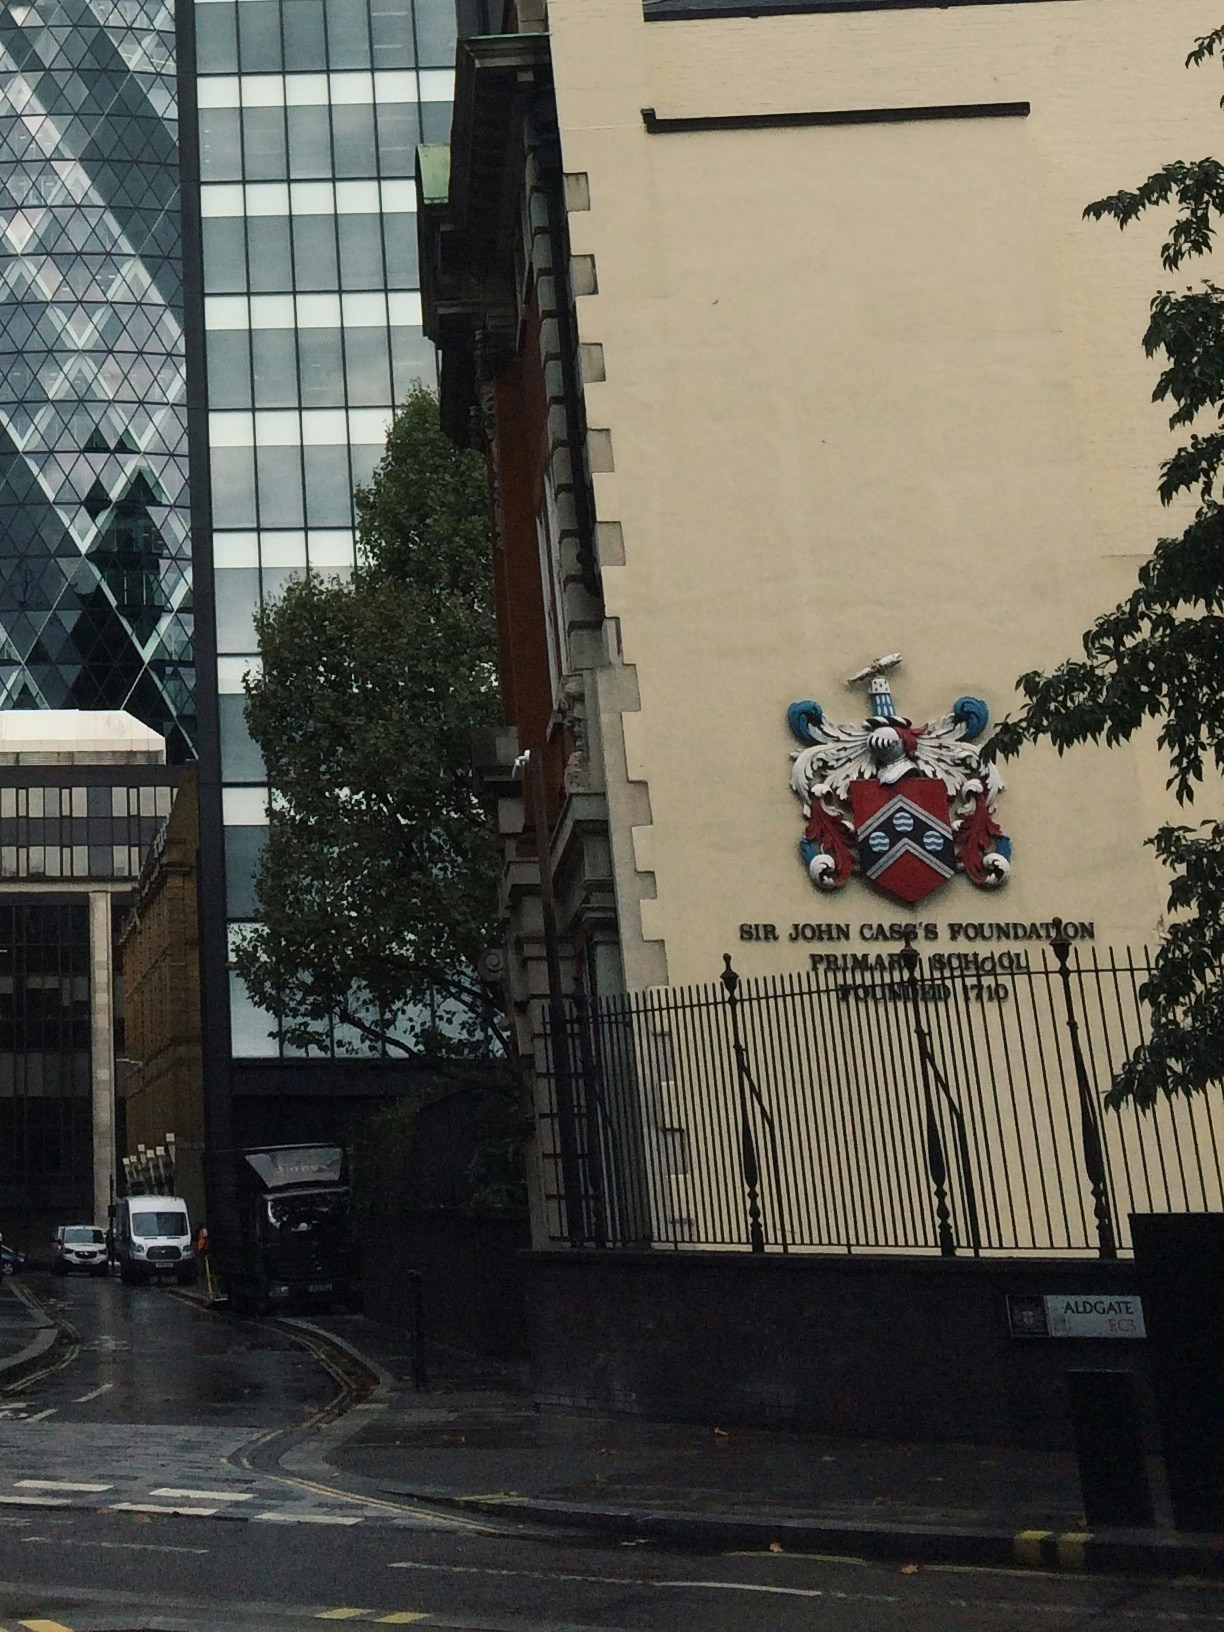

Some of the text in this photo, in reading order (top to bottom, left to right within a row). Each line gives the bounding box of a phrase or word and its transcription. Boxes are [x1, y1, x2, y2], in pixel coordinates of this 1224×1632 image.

[739, 921, 1095, 941] SIR JOHN CASS'S FOUNDATON
[809, 952, 1030, 973] PRIMAR SCHOOL
[1063, 1300, 1135, 1315] ALDGATE
[1107, 1318, 1138, 1333] EC3
